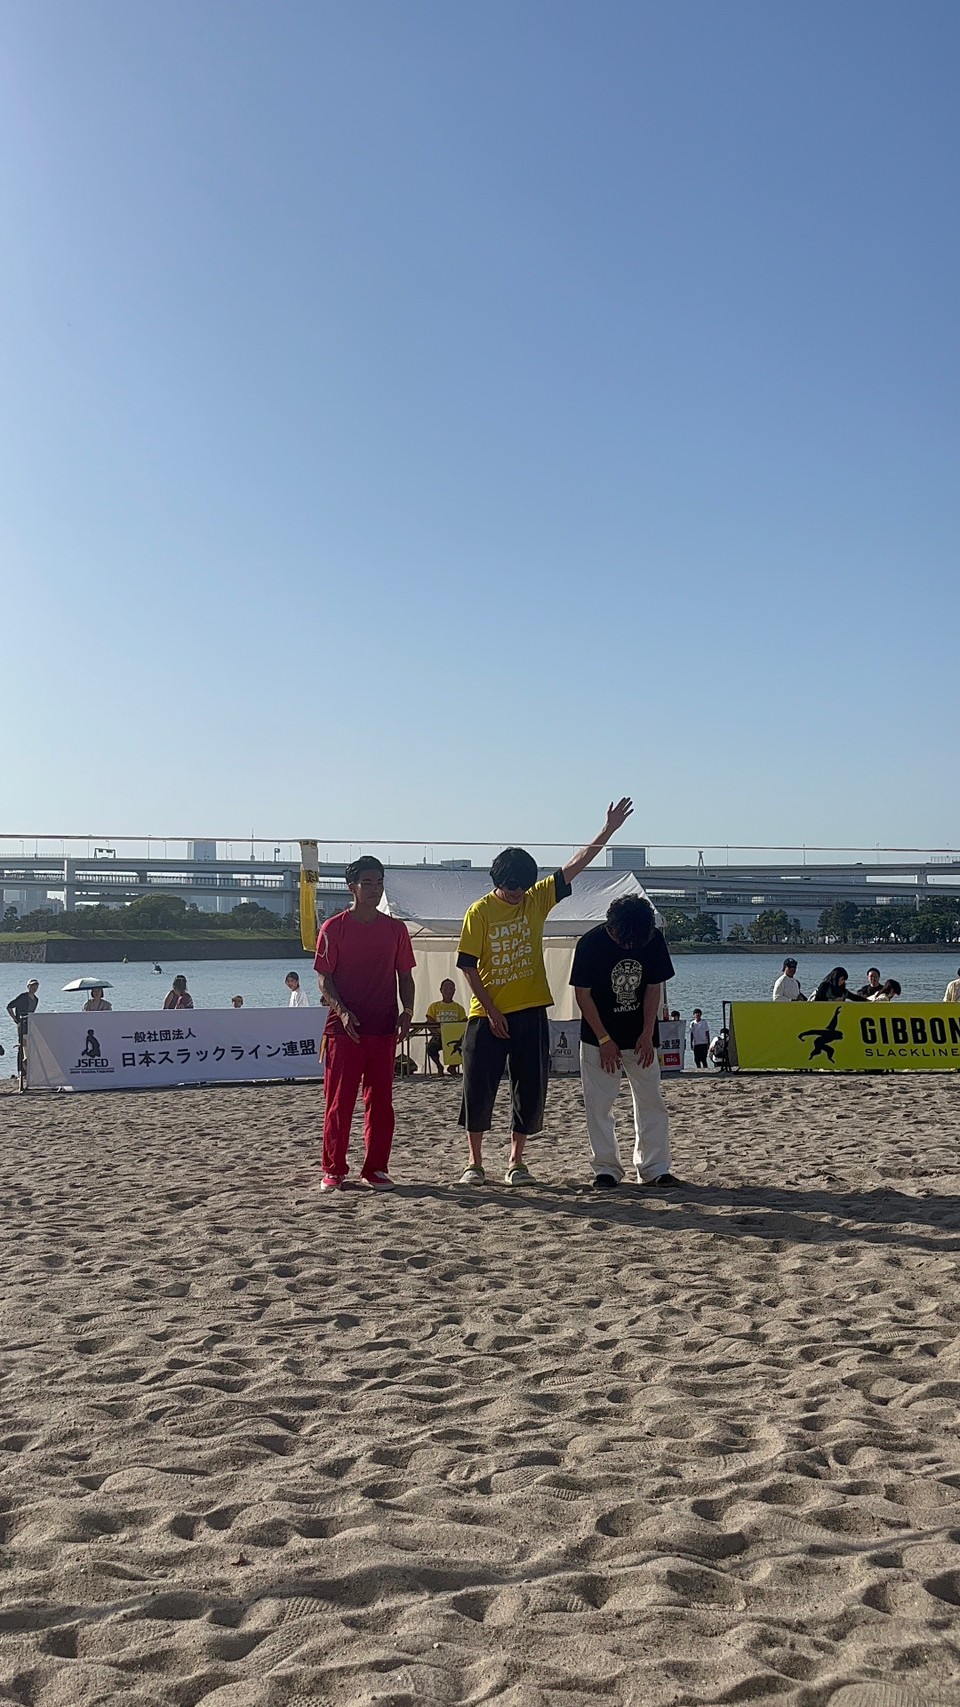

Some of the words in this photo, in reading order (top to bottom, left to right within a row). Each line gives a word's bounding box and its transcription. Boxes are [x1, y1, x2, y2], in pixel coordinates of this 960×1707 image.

[121, 1027, 197, 1043] 一般社団法人
[121, 1039, 318, 1068] 日本スラックライン連盟
[865, 1048, 960, 1057] SLACKLINE
[75, 1058, 109, 1068] JSFED
